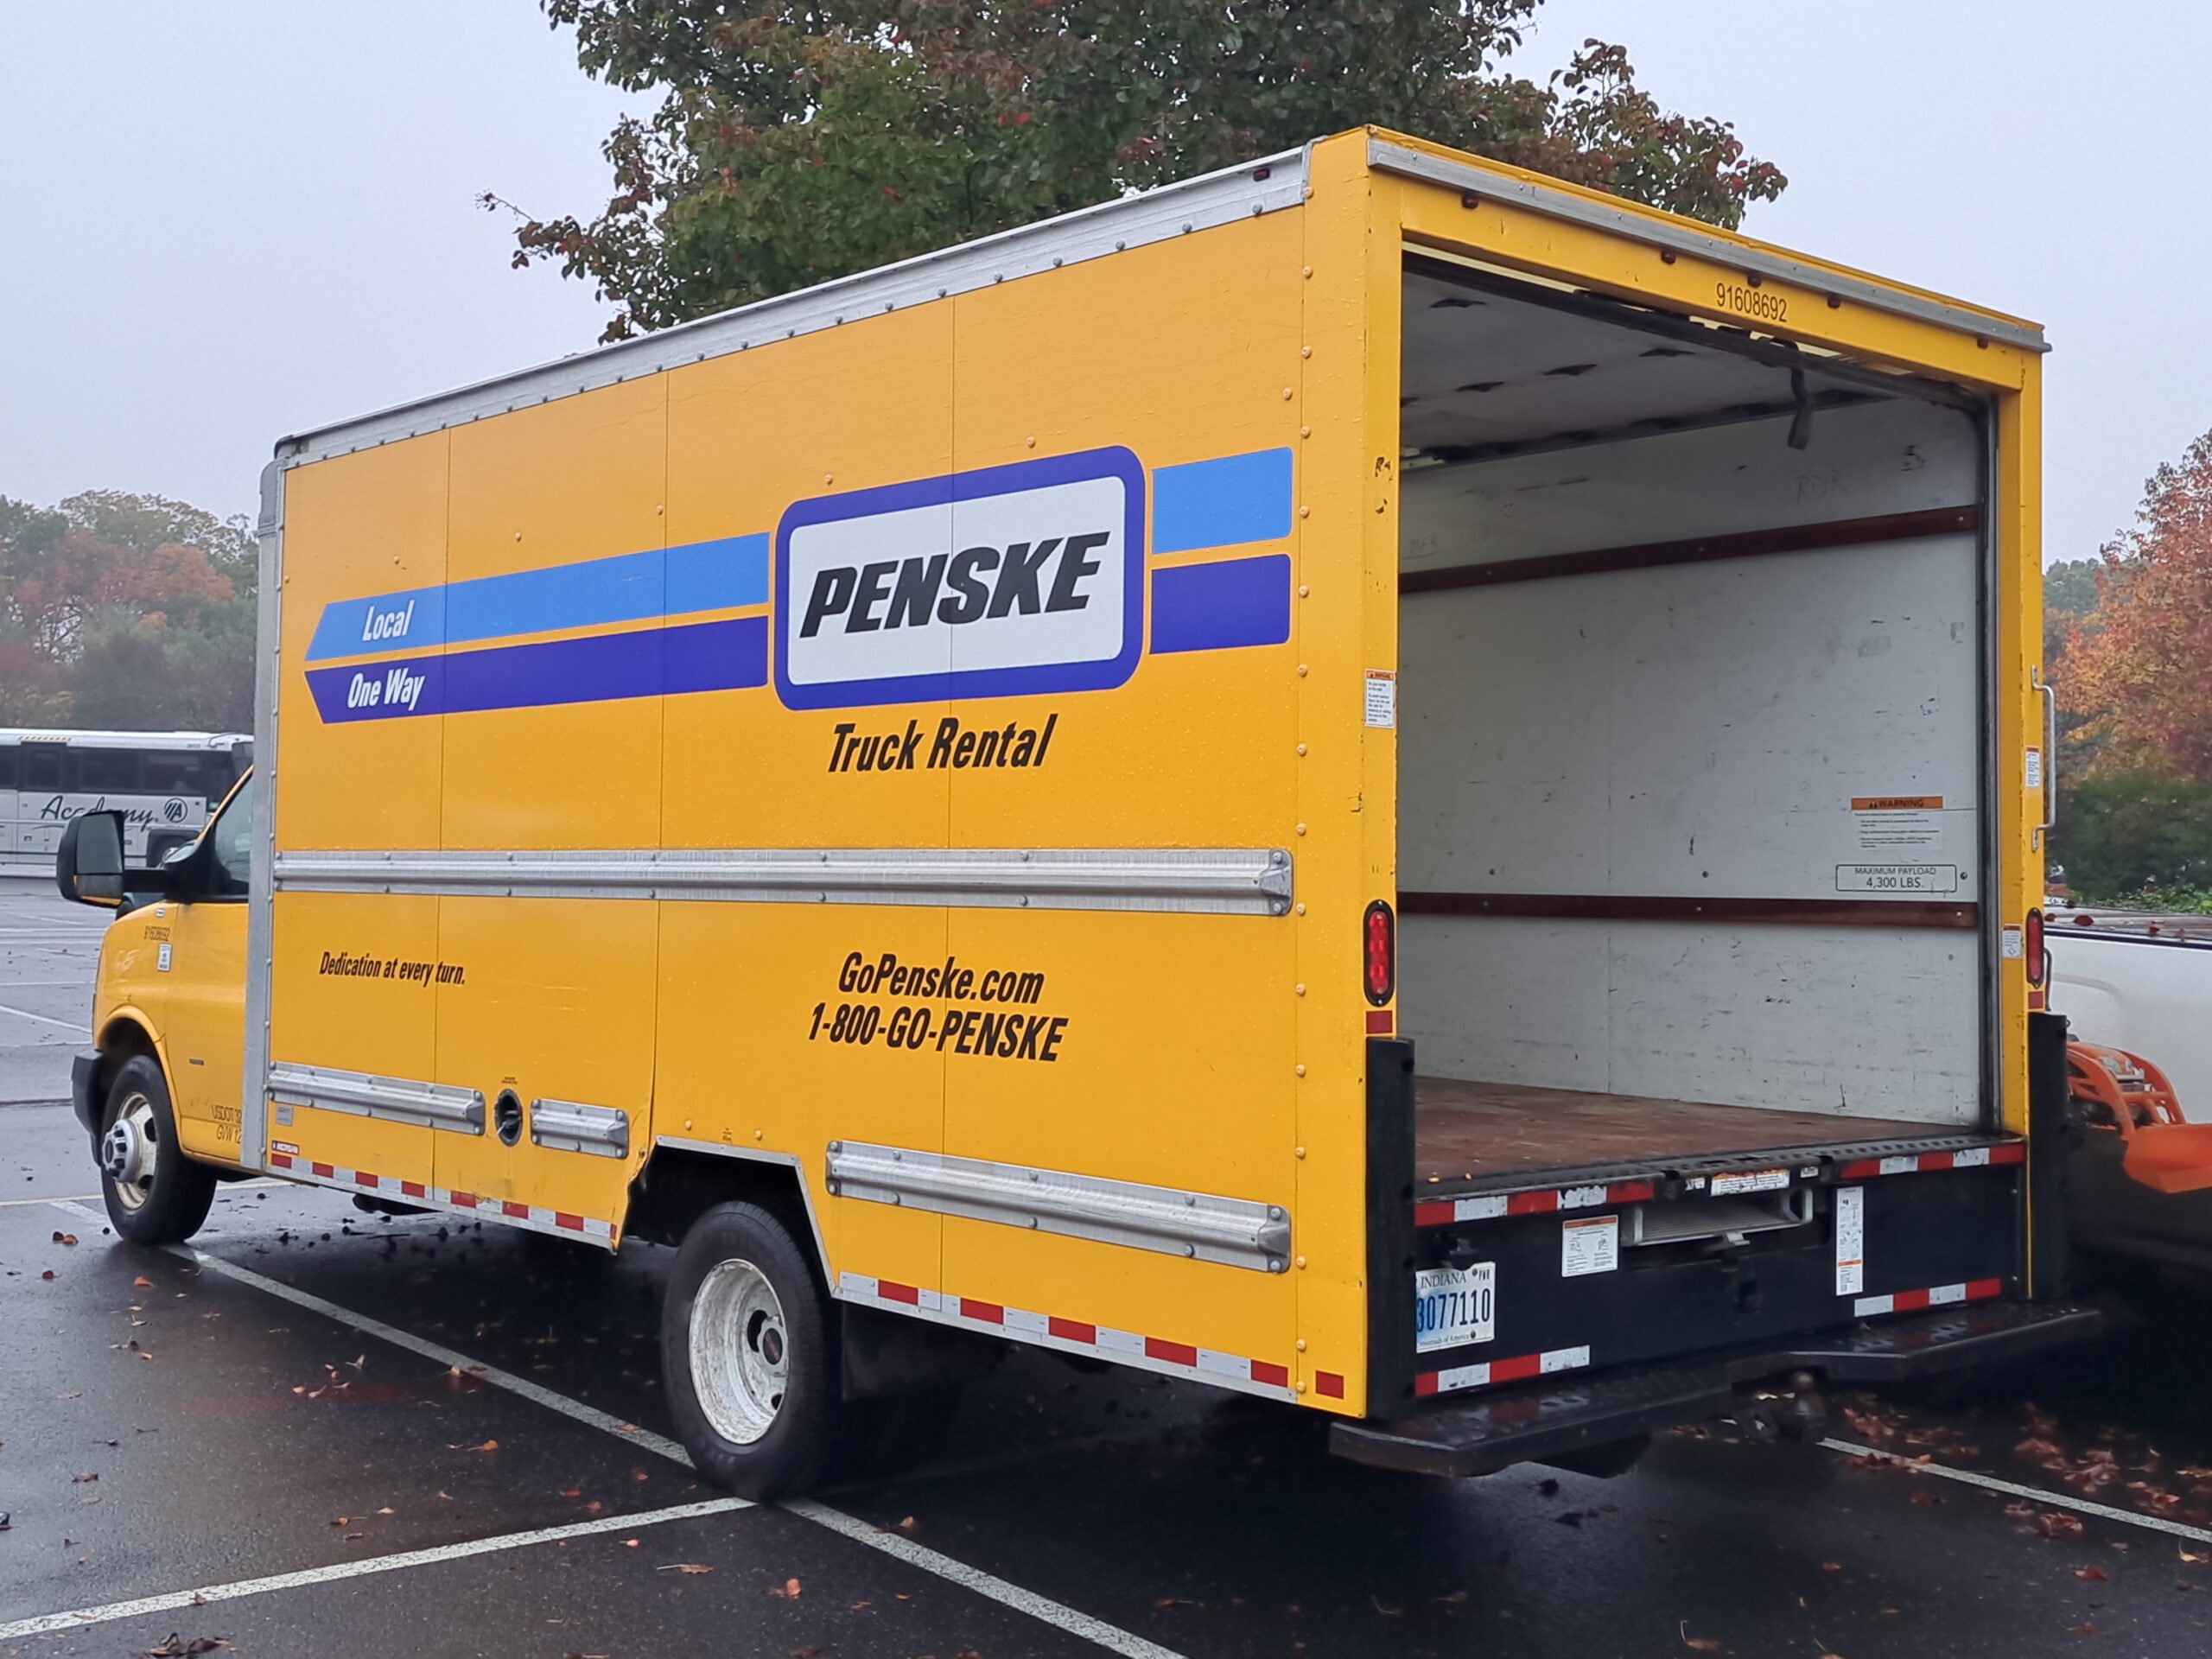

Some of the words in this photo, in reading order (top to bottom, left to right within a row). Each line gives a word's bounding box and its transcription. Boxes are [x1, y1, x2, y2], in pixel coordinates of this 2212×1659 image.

[1716, 283, 1787, 322] 91608692
[799, 531, 1110, 639] PENSKE
[362, 599, 415, 641] Local
[347, 672, 382, 709] One
[384, 667, 426, 711] Way
[828, 719, 924, 772] Truck
[926, 713, 1058, 769] Rental
[1878, 799, 1924, 809] WARNING
[1866, 877, 1897, 889] 4,300
[1900, 877, 1925, 888] LBS.
[1897, 867, 1936, 875] PAYLOAD
[320, 951, 382, 977] Dedication
[383, 957, 398, 979] at
[399, 962, 434, 988] every
[435, 961, 465, 985] turn.
[838, 951, 1045, 1004] GoPenske.com
[809, 1002, 1069, 1062] 1-800-GO-PENSKE
[216, 1123, 234, 1142] GVW
[1421, 1272, 1466, 1288] INDIANA
[1417, 1288, 1491, 1332] 3077110
